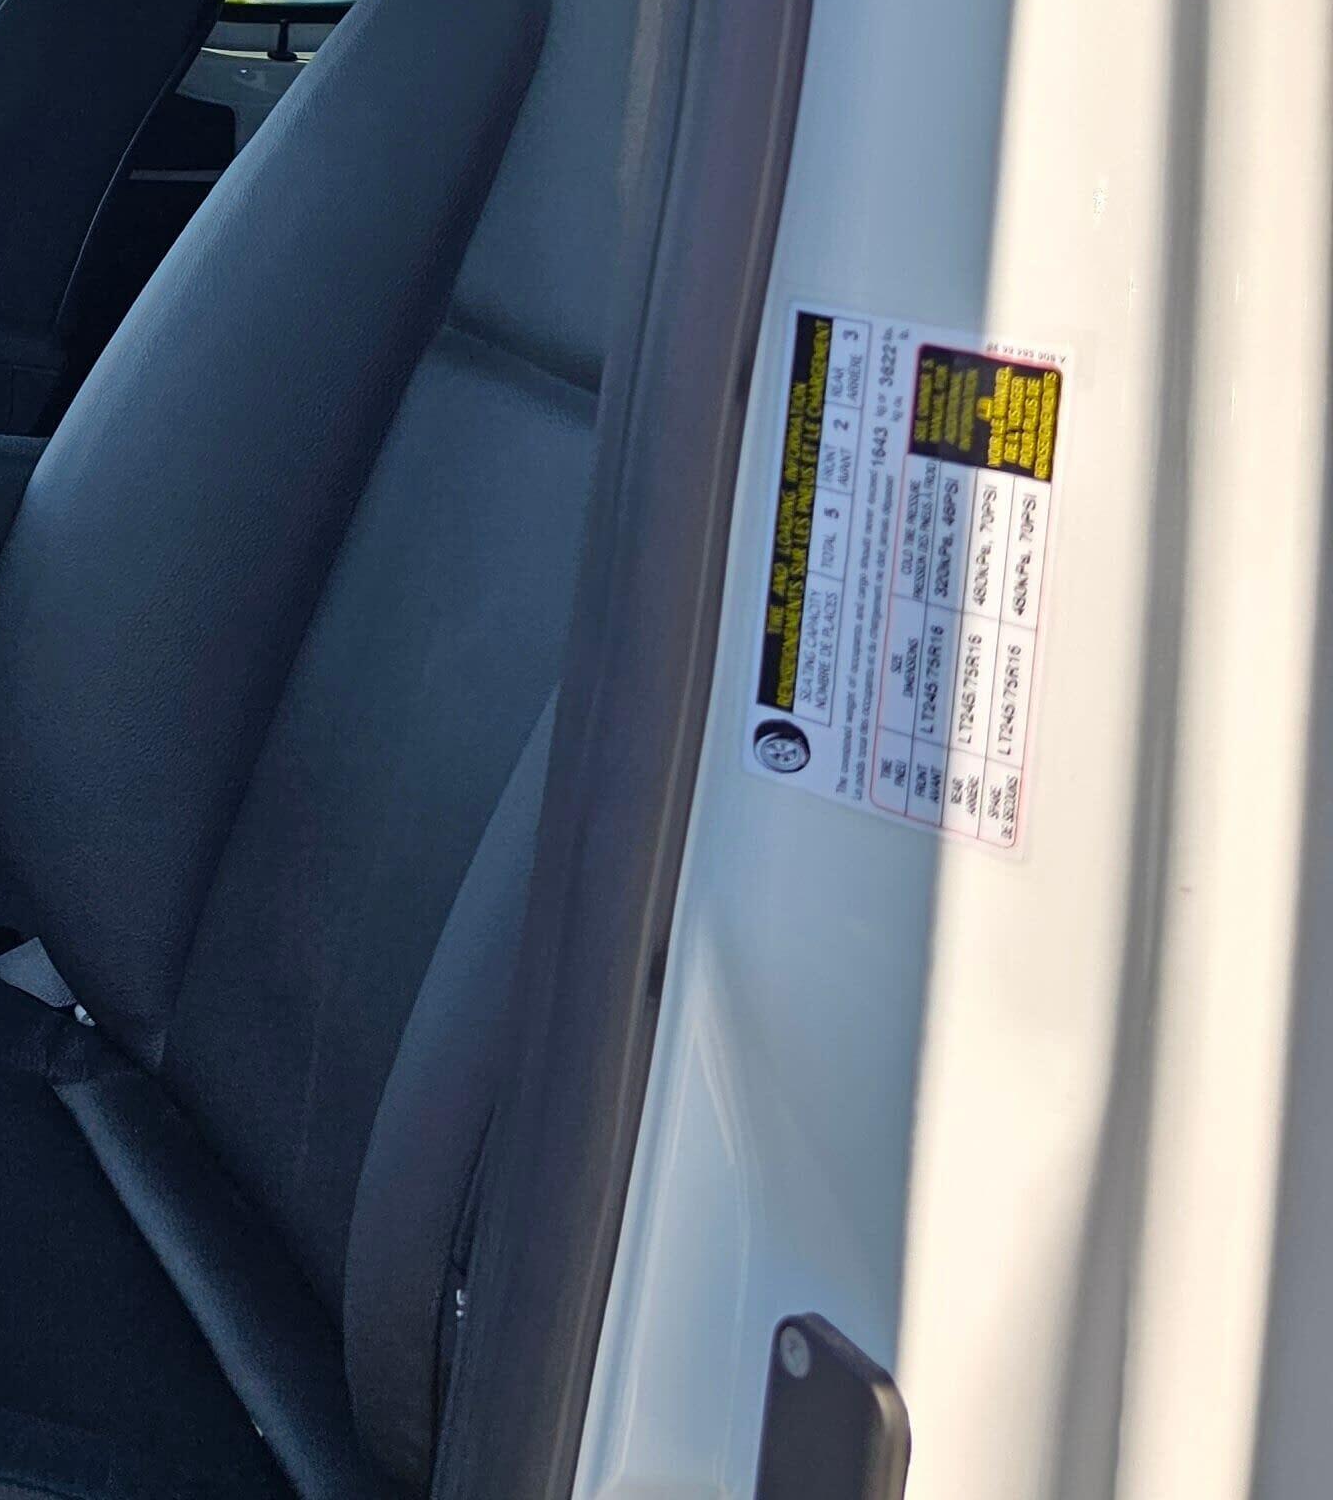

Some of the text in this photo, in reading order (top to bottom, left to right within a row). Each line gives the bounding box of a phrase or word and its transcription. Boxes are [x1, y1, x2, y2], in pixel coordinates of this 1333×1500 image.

[843, 329, 857, 340] 3
[784, 381, 805, 482] INFORMATION
[833, 418, 848, 430] 2
[871, 426, 887, 467] 1643
[980, 484, 996, 533] 70PSI
[1019, 493, 1036, 542] 70PSI
[821, 506, 838, 568] TOTAL 5
